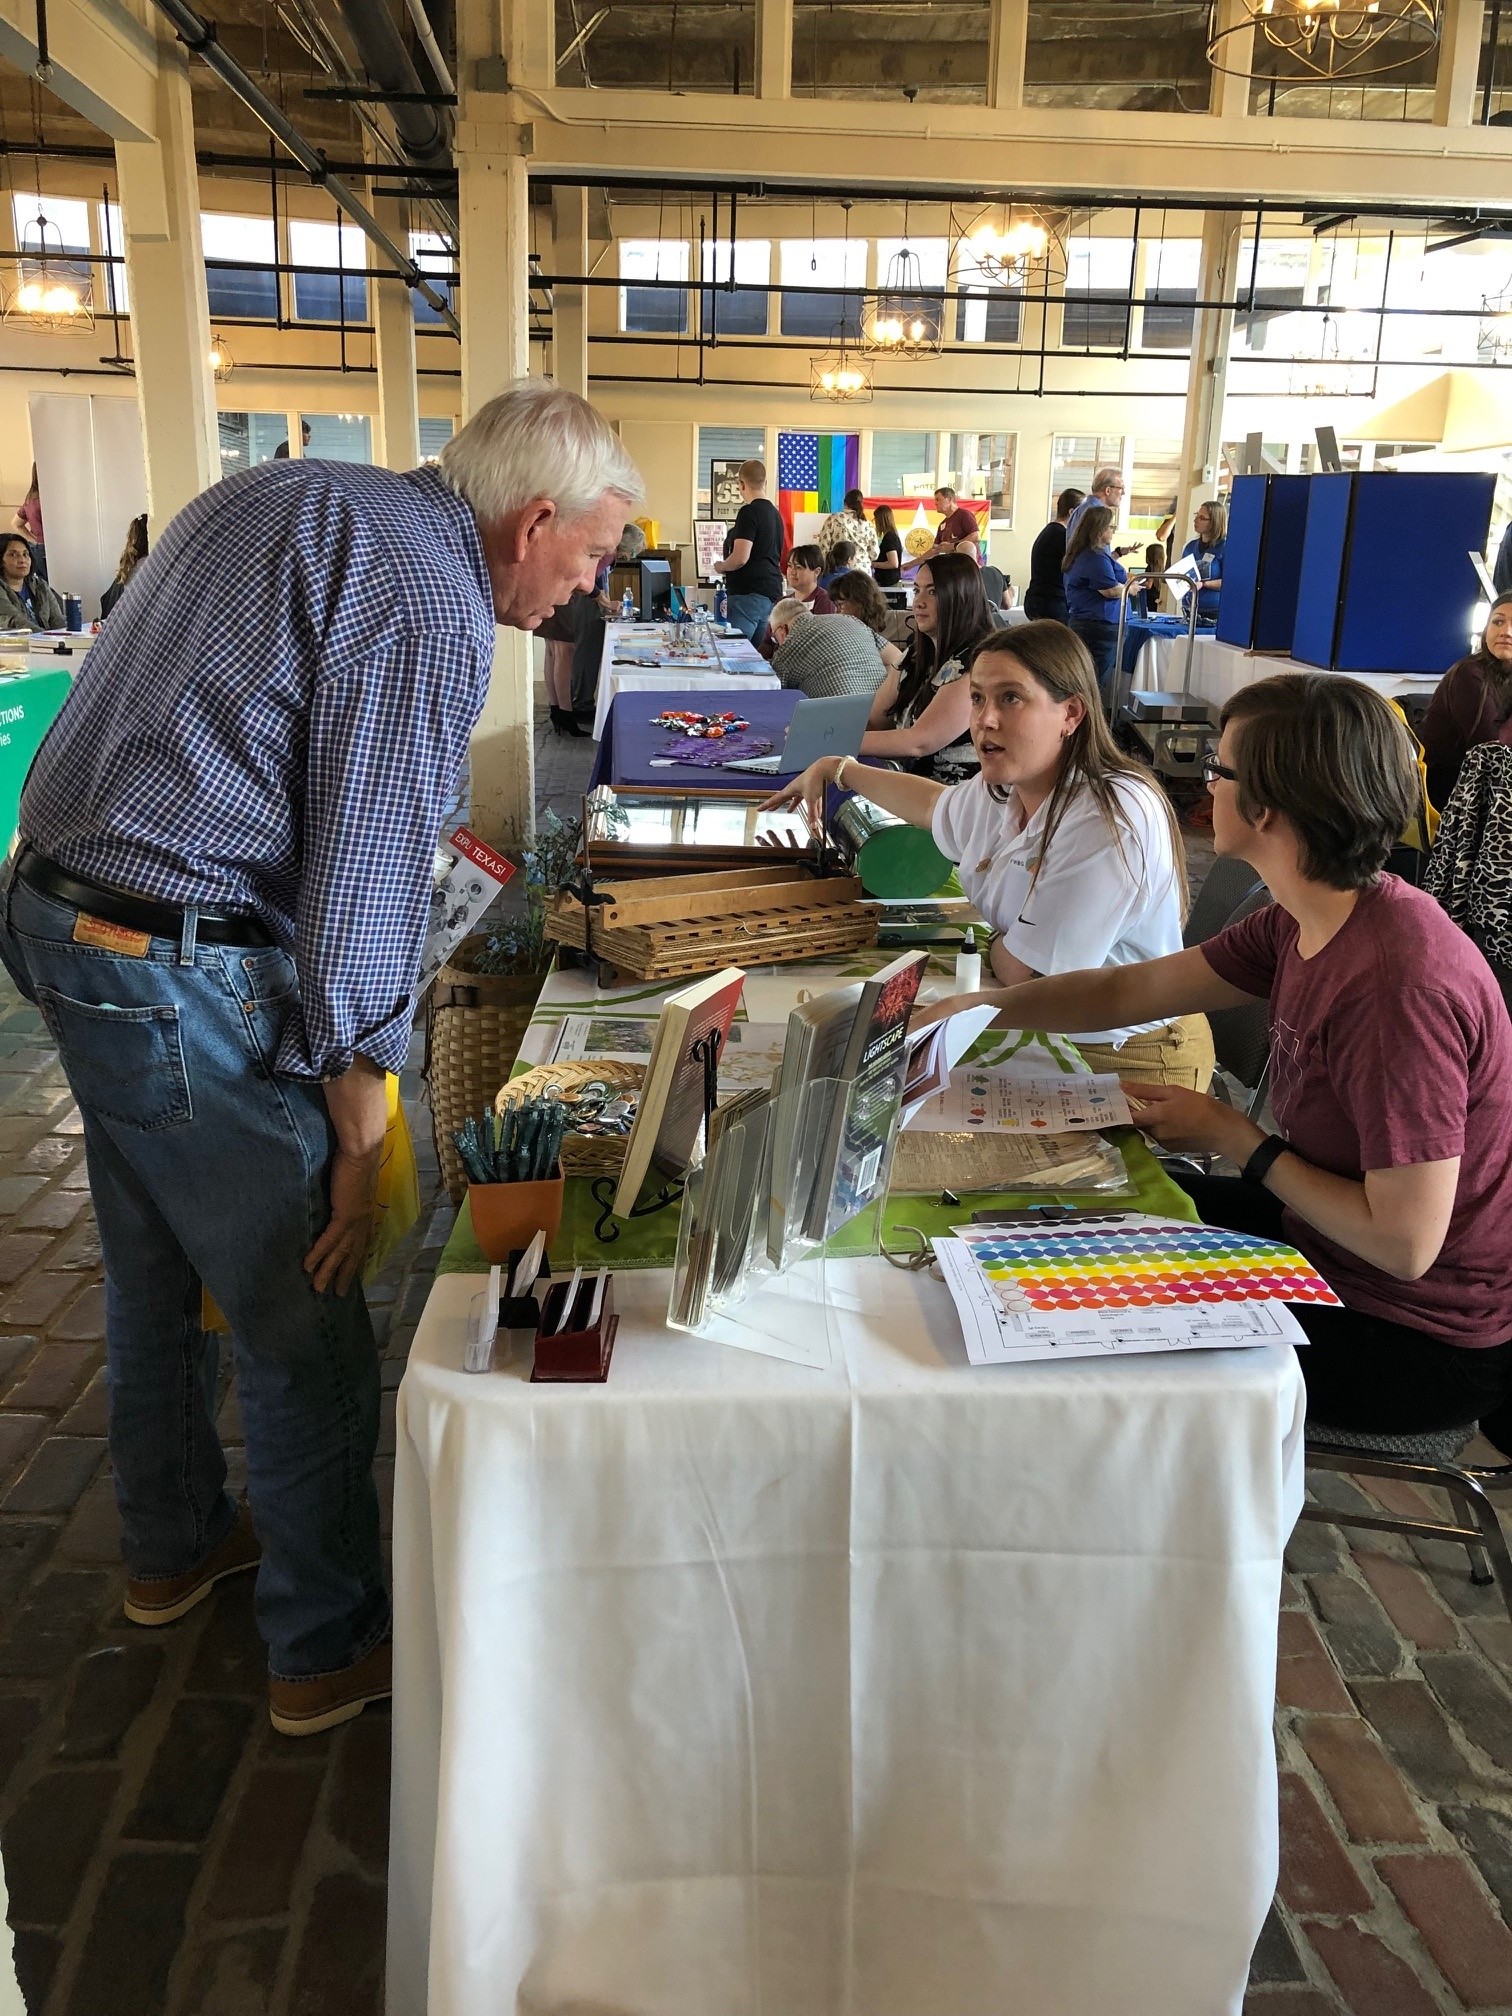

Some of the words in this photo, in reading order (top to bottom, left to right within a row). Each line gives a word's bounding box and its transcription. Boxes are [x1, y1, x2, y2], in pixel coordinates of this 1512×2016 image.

[455, 832, 471, 850] EXPL
[472, 846, 506, 876] TEXAS!
[863, 1026, 904, 1063] LIGHTSCAPE
